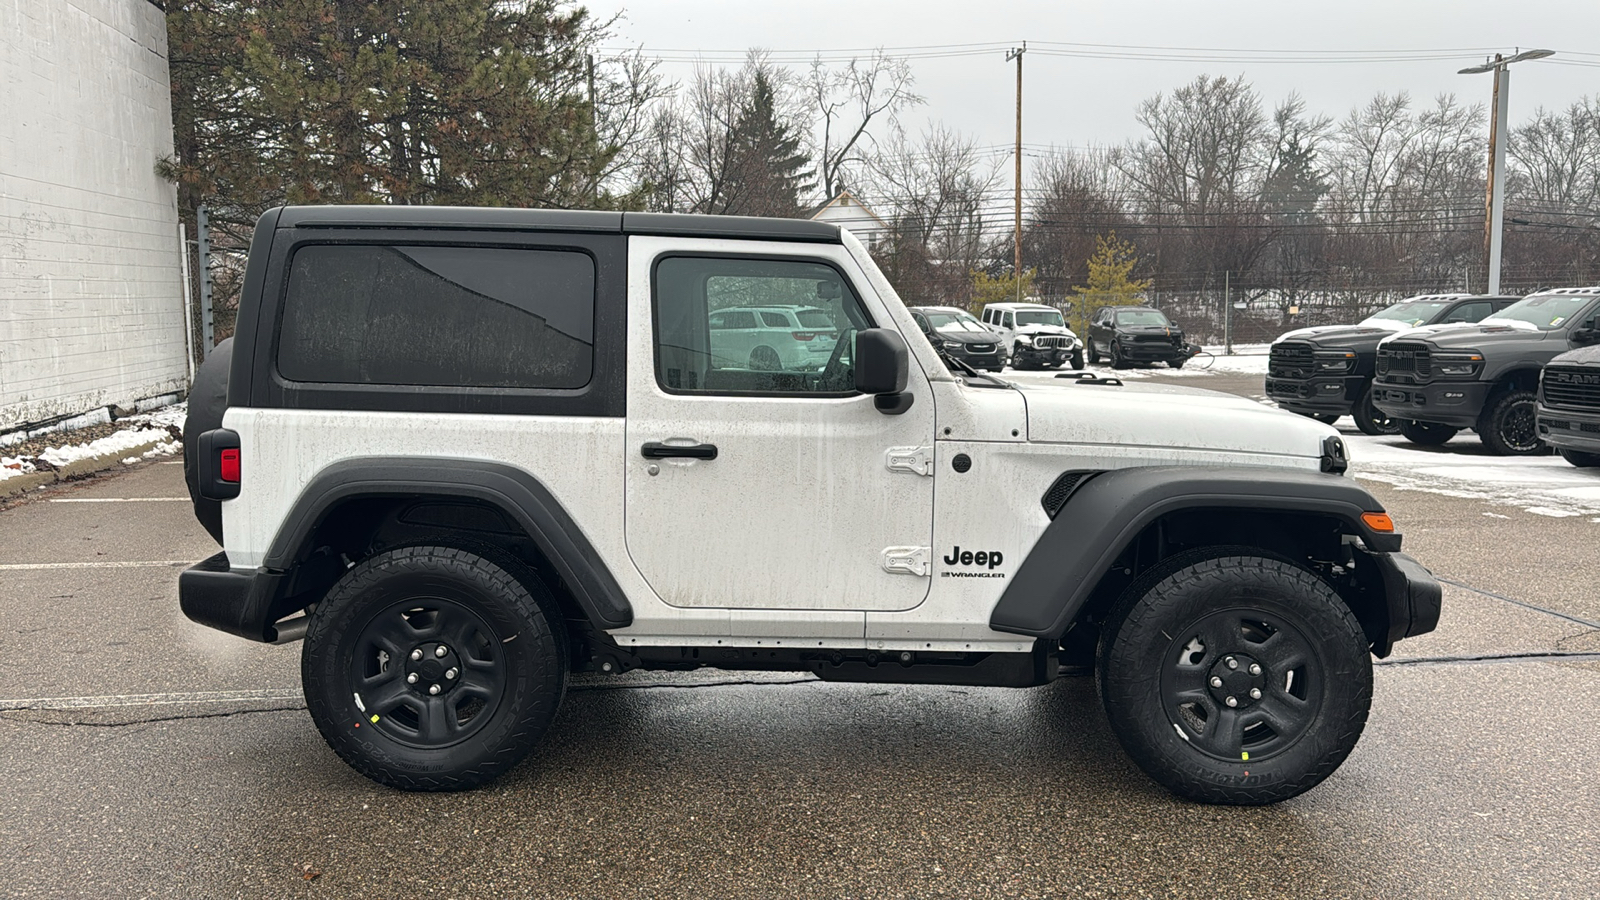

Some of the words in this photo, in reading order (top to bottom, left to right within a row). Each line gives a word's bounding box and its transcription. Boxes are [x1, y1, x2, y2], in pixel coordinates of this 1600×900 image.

[1387, 351, 1413, 360] RAM
[1558, 373, 1599, 384] RAM
[943, 545, 1003, 570] Jeep
